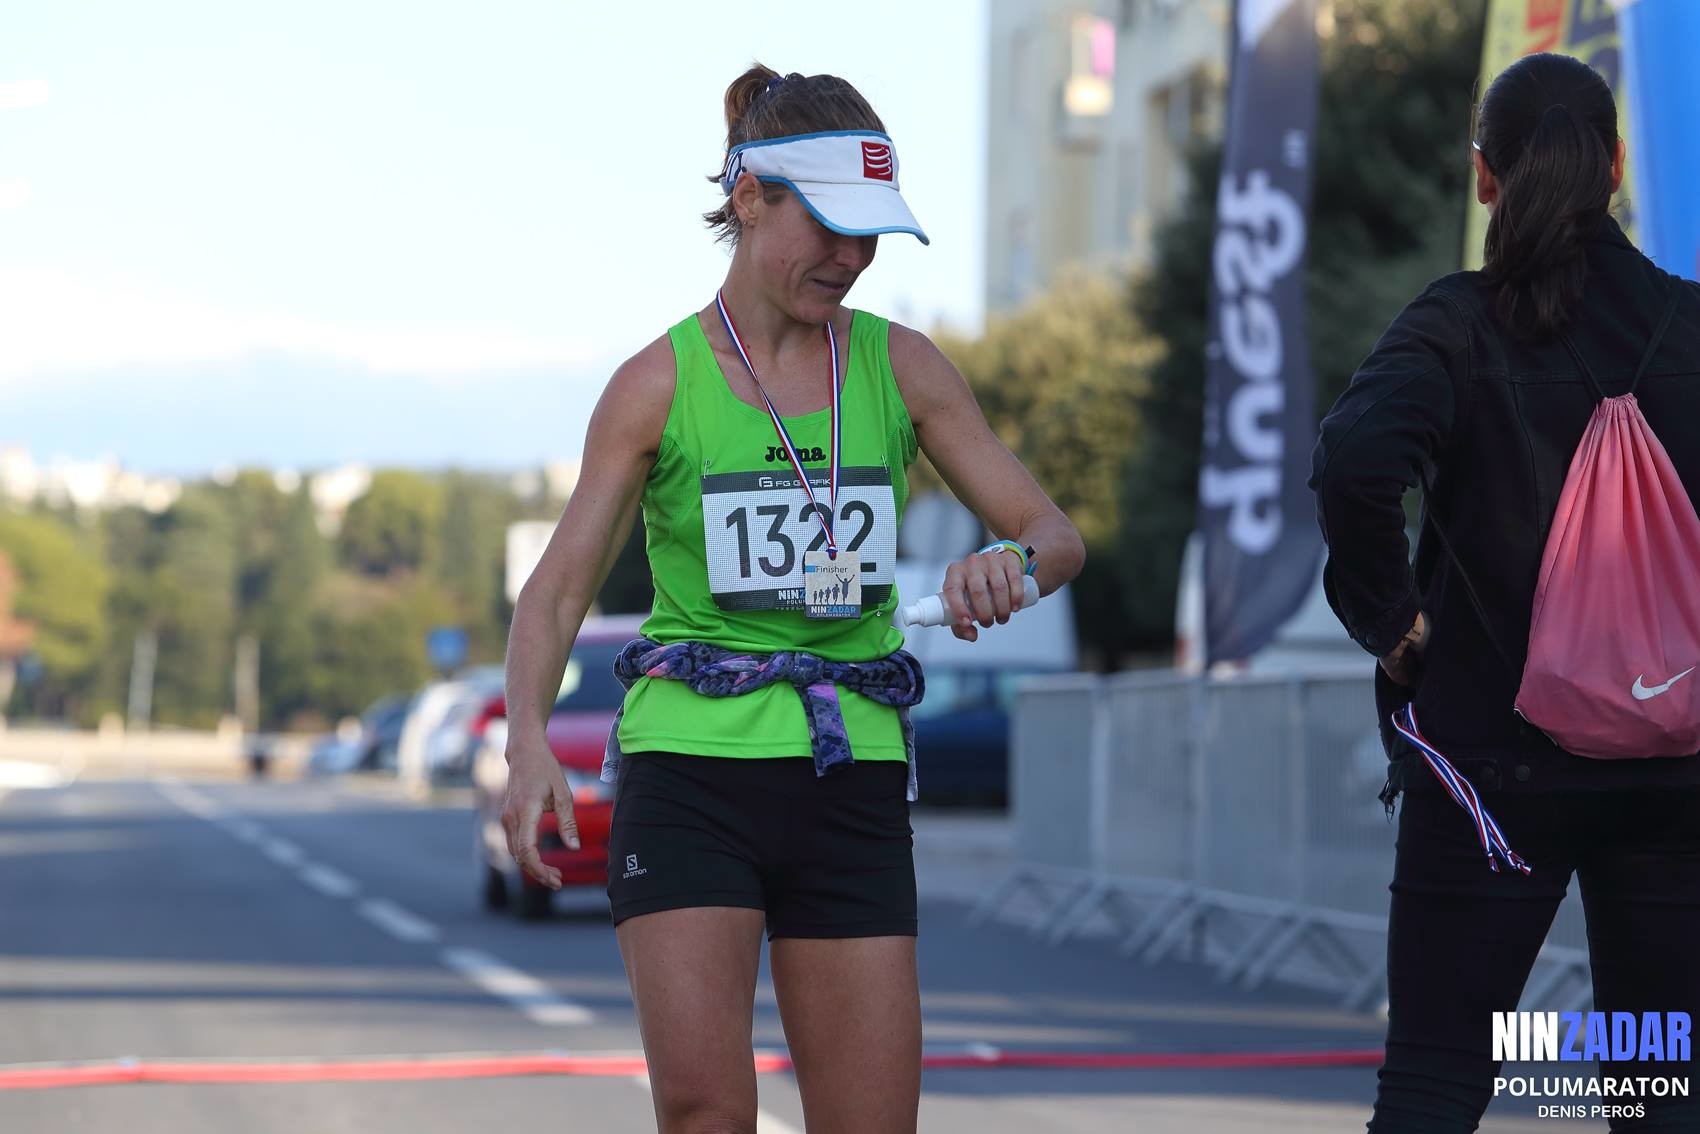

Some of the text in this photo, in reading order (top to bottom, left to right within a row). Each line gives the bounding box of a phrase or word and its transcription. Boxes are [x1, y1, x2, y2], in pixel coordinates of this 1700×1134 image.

[726, 500, 877, 579] 1322
[815, 565, 848, 573] Finisher
[778, 589, 806, 600] NINZ
[811, 606, 857, 614] NINZADAR
